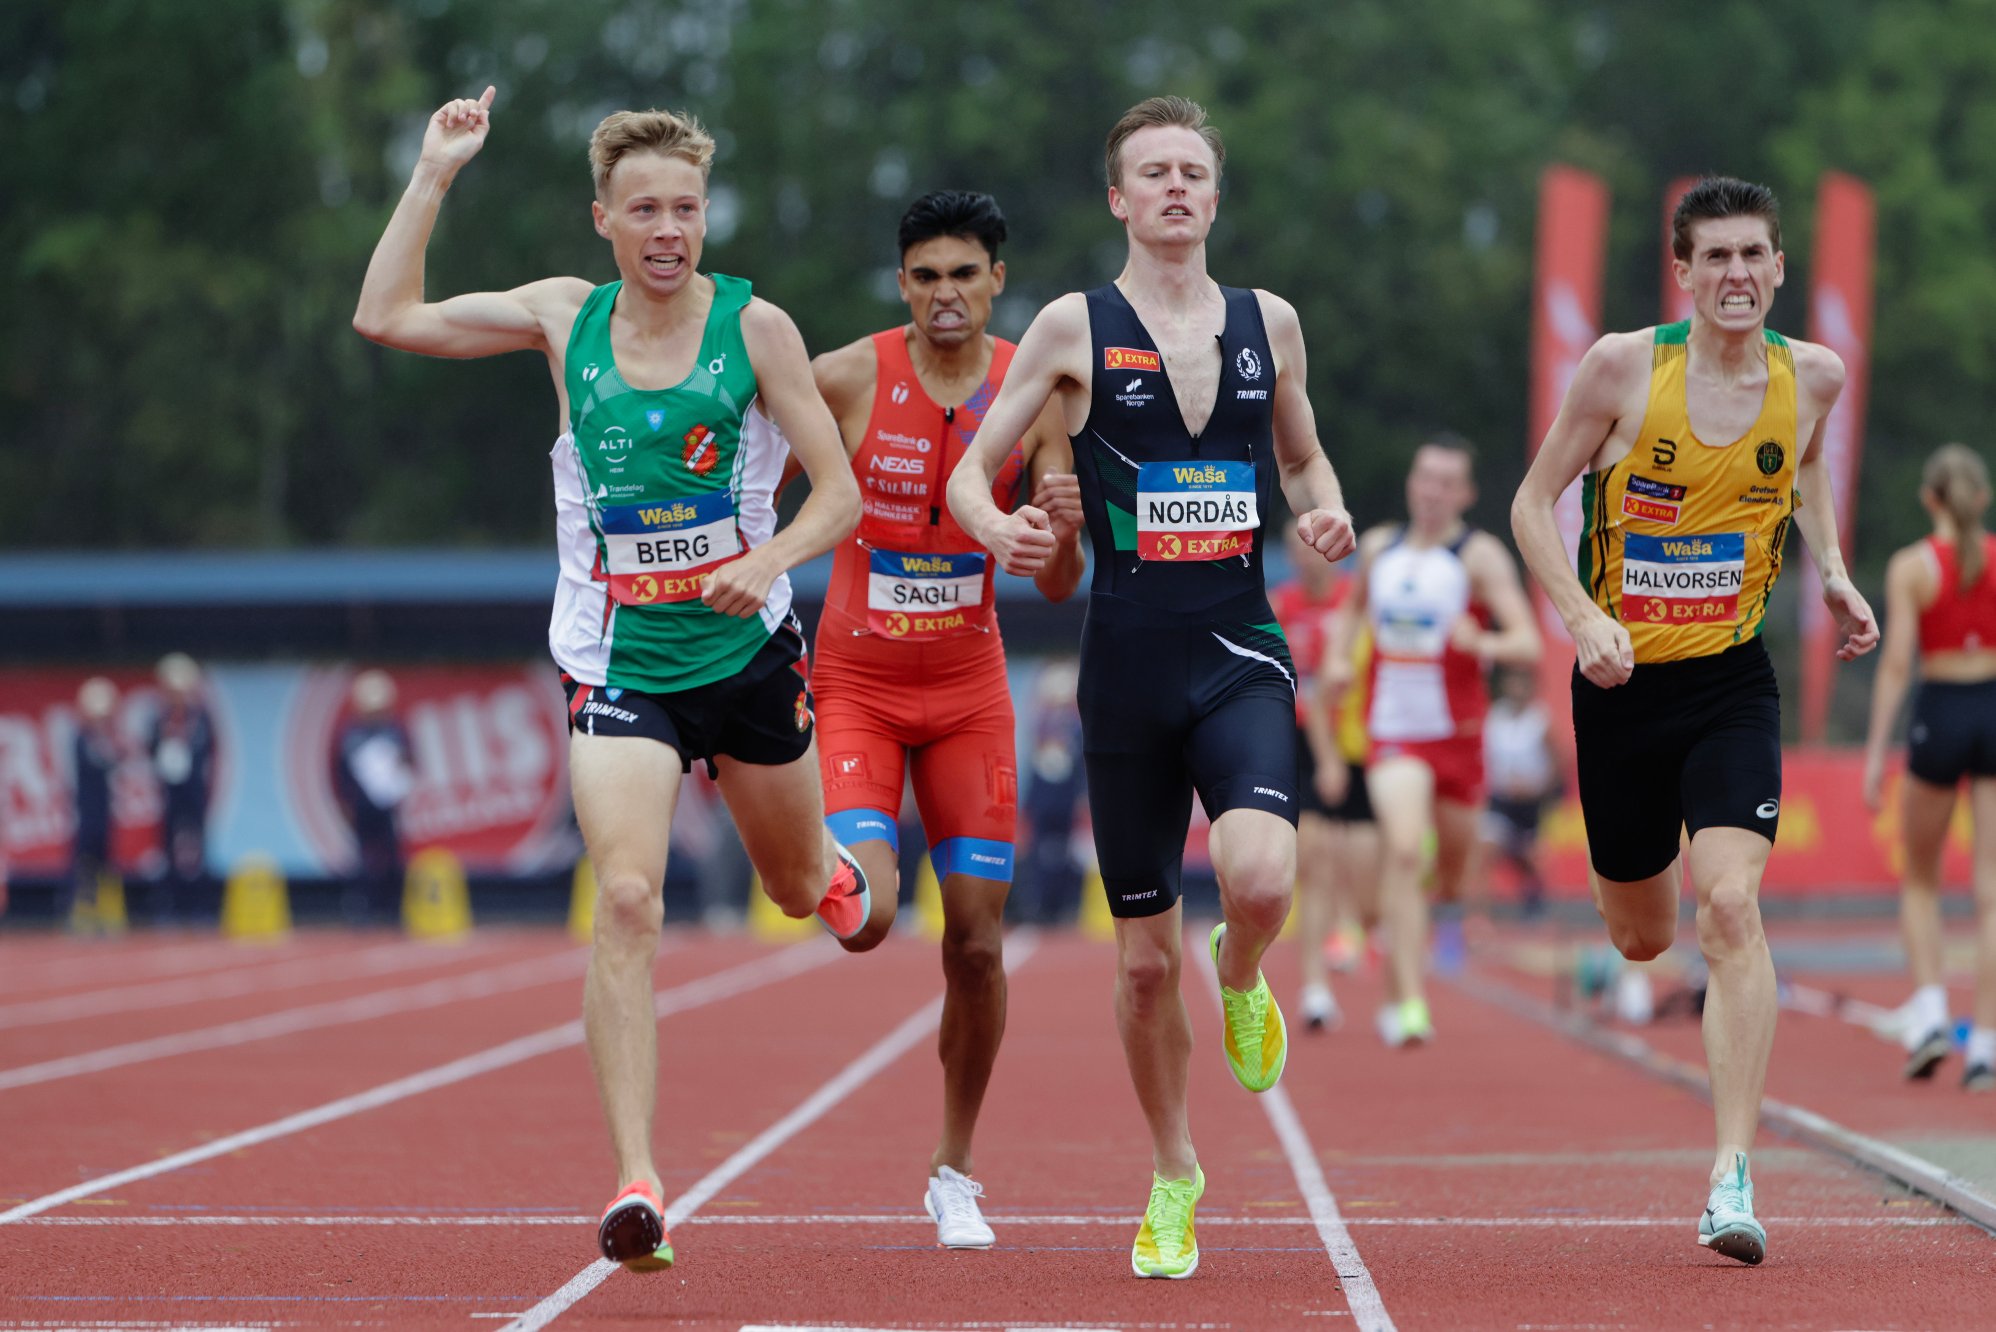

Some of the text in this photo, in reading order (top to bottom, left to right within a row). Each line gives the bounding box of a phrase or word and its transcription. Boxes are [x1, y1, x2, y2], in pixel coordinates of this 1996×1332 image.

[1125, 353, 1157, 366] EXTRA
[1115, 394, 1155, 402] Sparebanken
[1236, 390, 1267, 400] TRIMTEX
[1126, 400, 1145, 408] Norge
[599, 438, 633, 451] ALTI
[870, 454, 925, 474] NEAS
[1173, 467, 1226, 484] Wasa
[638, 504, 698, 526] Wasa
[1150, 494, 1248, 524] NORDÅS
[1641, 504, 1674, 519] EXTRA
[637, 535, 710, 564] BERG
[1188, 536, 1239, 554] EXTRA
[1662, 541, 1713, 557] Wasa
[901, 556, 952, 573] Wasa
[1625, 568, 1742, 589] HALVORSEN
[893, 584, 959, 604] SAGLI
[1672, 603, 1725, 618] EXTRA
[914, 613, 965, 632] EXTRA
[583, 701, 639, 724] TRIMTEX
[1253, 786, 1289, 802] TRIMTEX
[1121, 889, 1158, 901] TRIMTEX
